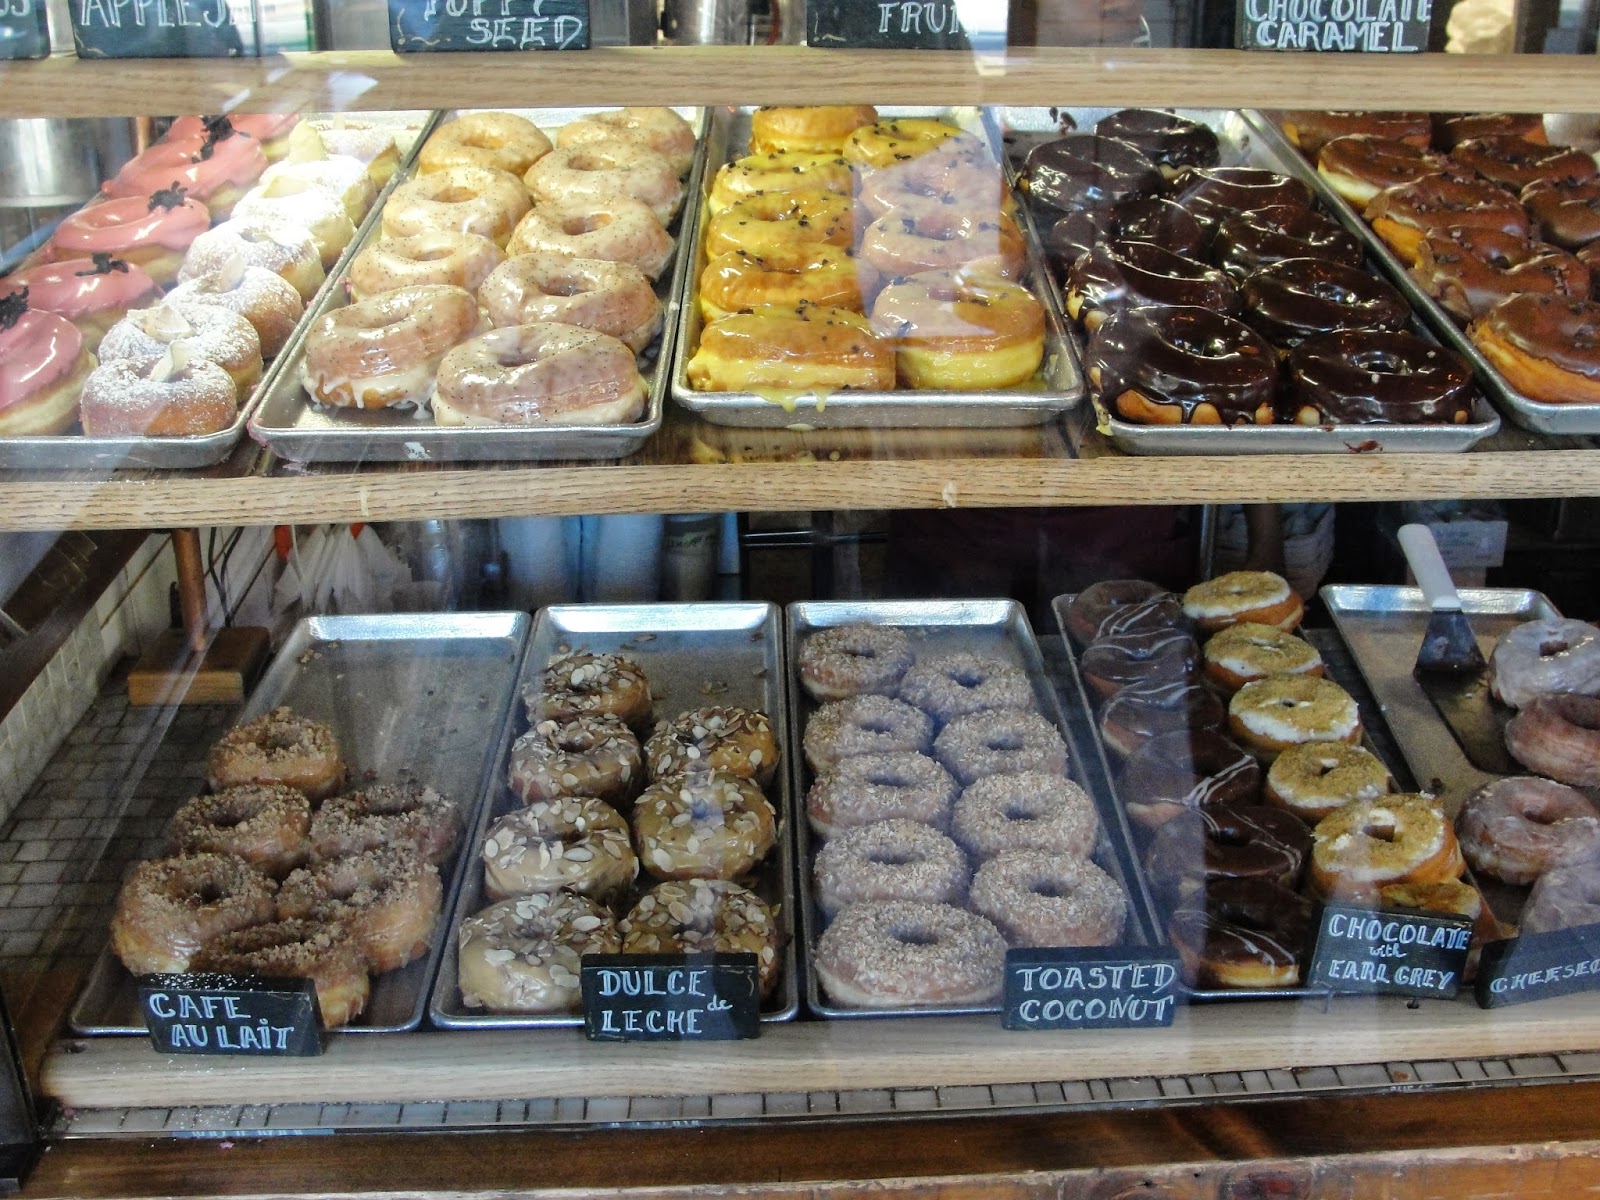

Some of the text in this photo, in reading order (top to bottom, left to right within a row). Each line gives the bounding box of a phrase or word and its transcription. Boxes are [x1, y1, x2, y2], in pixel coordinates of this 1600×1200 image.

[878, 2, 968, 37] FRUI
[1245, 0, 1433, 22] CHOCOLATE
[466, 16, 582, 50] SEED
[1256, 20, 1418, 51] CARAMEL
[1328, 914, 1471, 949] CHOCOLATE
[1369, 943, 1407, 957] with
[597, 969, 707, 996] DULCE
[1016, 963, 1175, 994] TOASTED
[1328, 959, 1455, 990] EARL GREY
[149, 993, 251, 1019] CAFE
[706, 995, 733, 1012] de
[1019, 994, 1173, 1021] COCONUT
[171, 1023, 208, 1047] AU
[601, 1009, 704, 1034] LECHE
